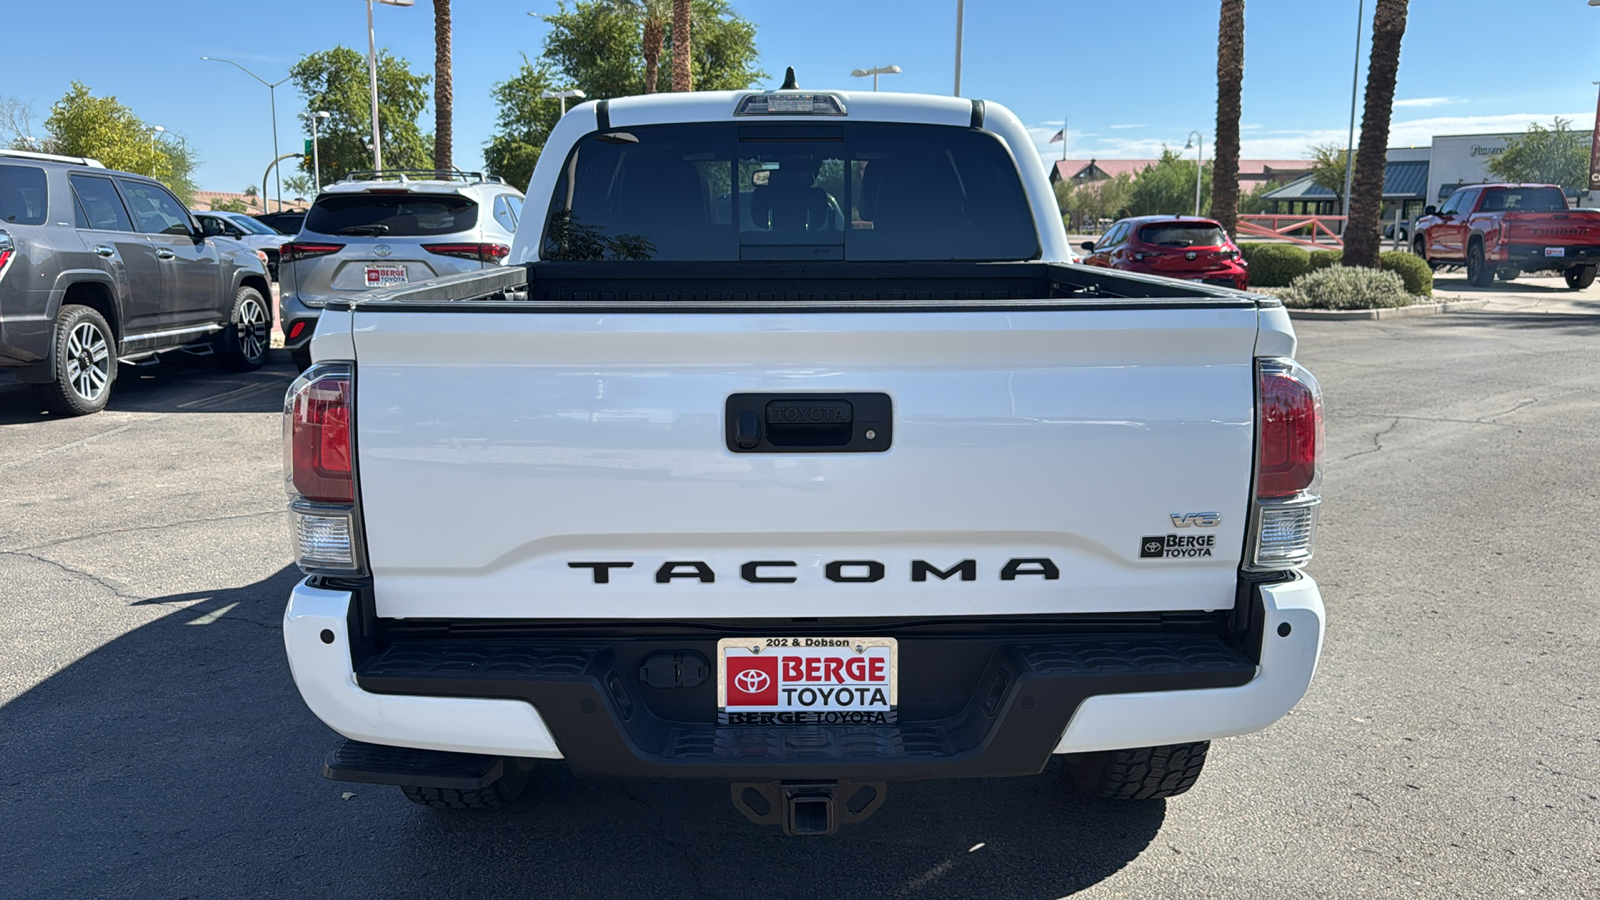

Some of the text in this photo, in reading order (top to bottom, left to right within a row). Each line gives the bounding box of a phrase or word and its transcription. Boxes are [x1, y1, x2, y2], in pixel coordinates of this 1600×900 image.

[774, 407, 846, 421] TOYOTA
[1170, 512, 1221, 528] V6
[1165, 534, 1215, 548] BERGE
[1164, 548, 1212, 558] TOYOTA
[567, 557, 1060, 584] TACOMA
[765, 638, 850, 647] 202 & Dobson
[781, 656, 886, 684] BERGE
[781, 687, 888, 706] TOYOTA
[728, 711, 809, 726] BERGE
[815, 711, 887, 724] TOYOTA
